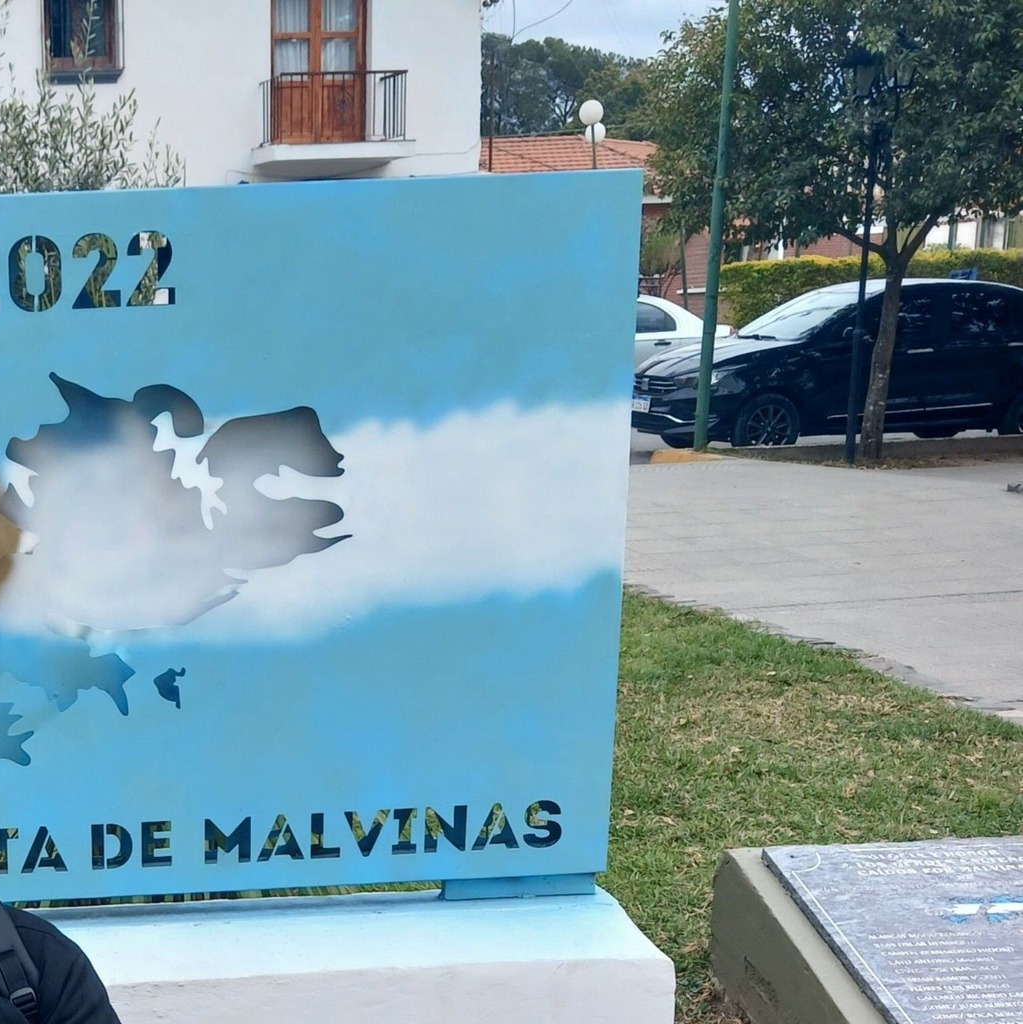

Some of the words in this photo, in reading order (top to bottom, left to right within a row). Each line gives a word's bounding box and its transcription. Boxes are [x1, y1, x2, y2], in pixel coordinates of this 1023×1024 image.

[91, 820, 173, 871] DE
[204, 800, 563, 865] MALVINAS
[944, 849, 1001, 858] HONOR
[922, 866, 955, 875] POR
